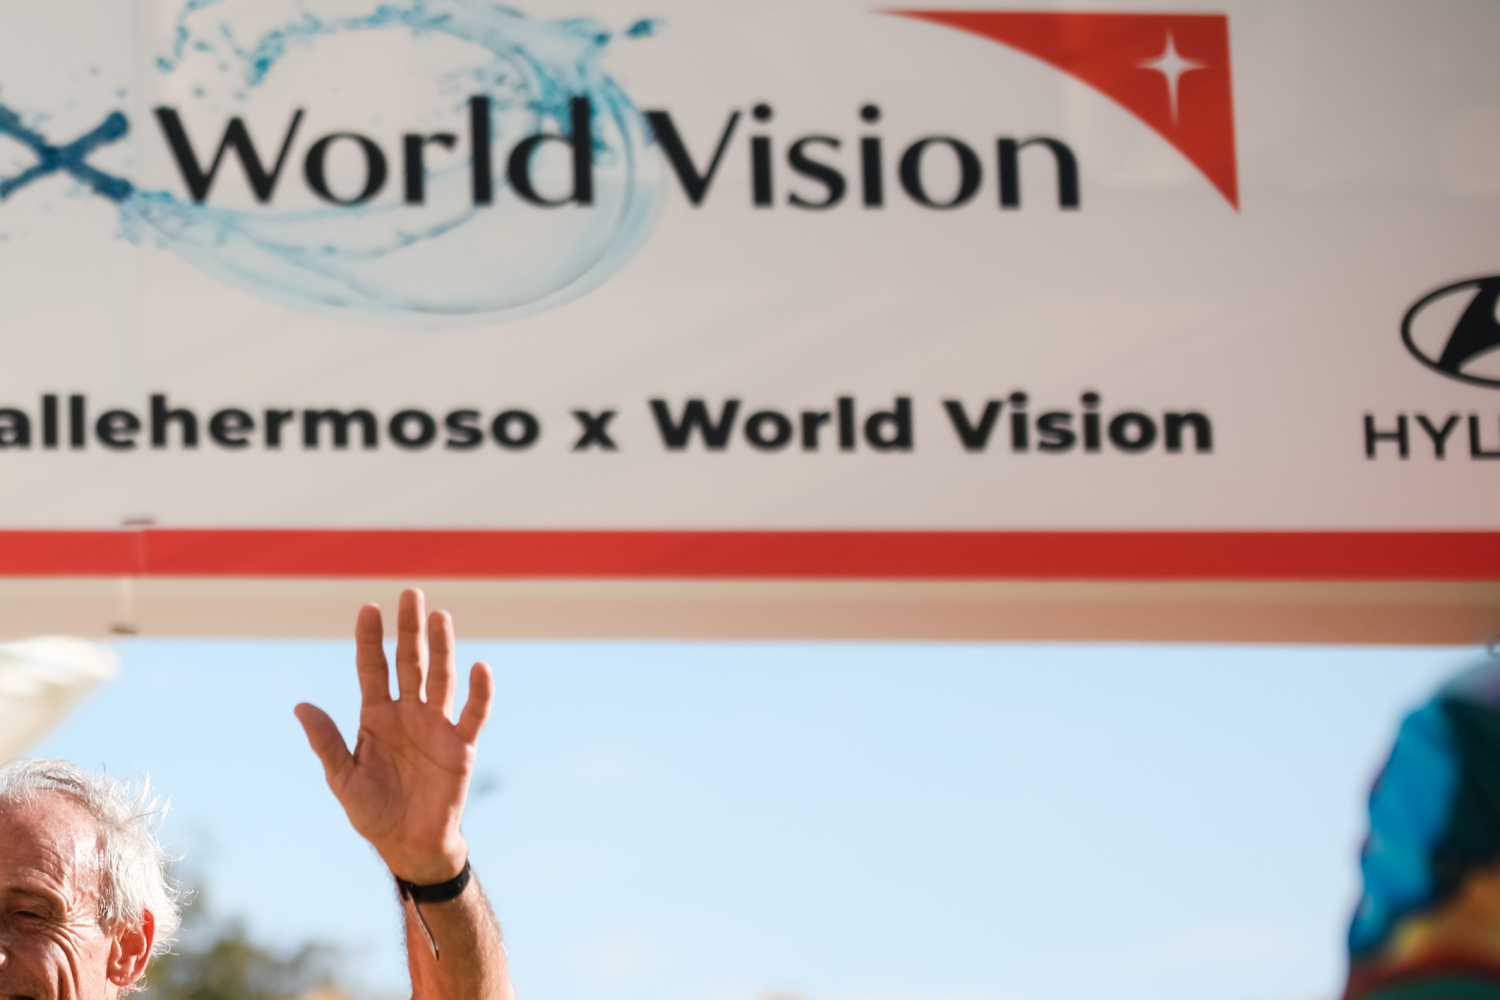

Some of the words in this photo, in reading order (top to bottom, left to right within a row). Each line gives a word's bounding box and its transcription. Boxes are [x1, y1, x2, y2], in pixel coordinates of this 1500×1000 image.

[152, 94, 601, 209] World
[640, 102, 1083, 211] Vision
[572, 409, 617, 451] x
[648, 395, 915, 453] World
[942, 390, 1214, 455] Vision
